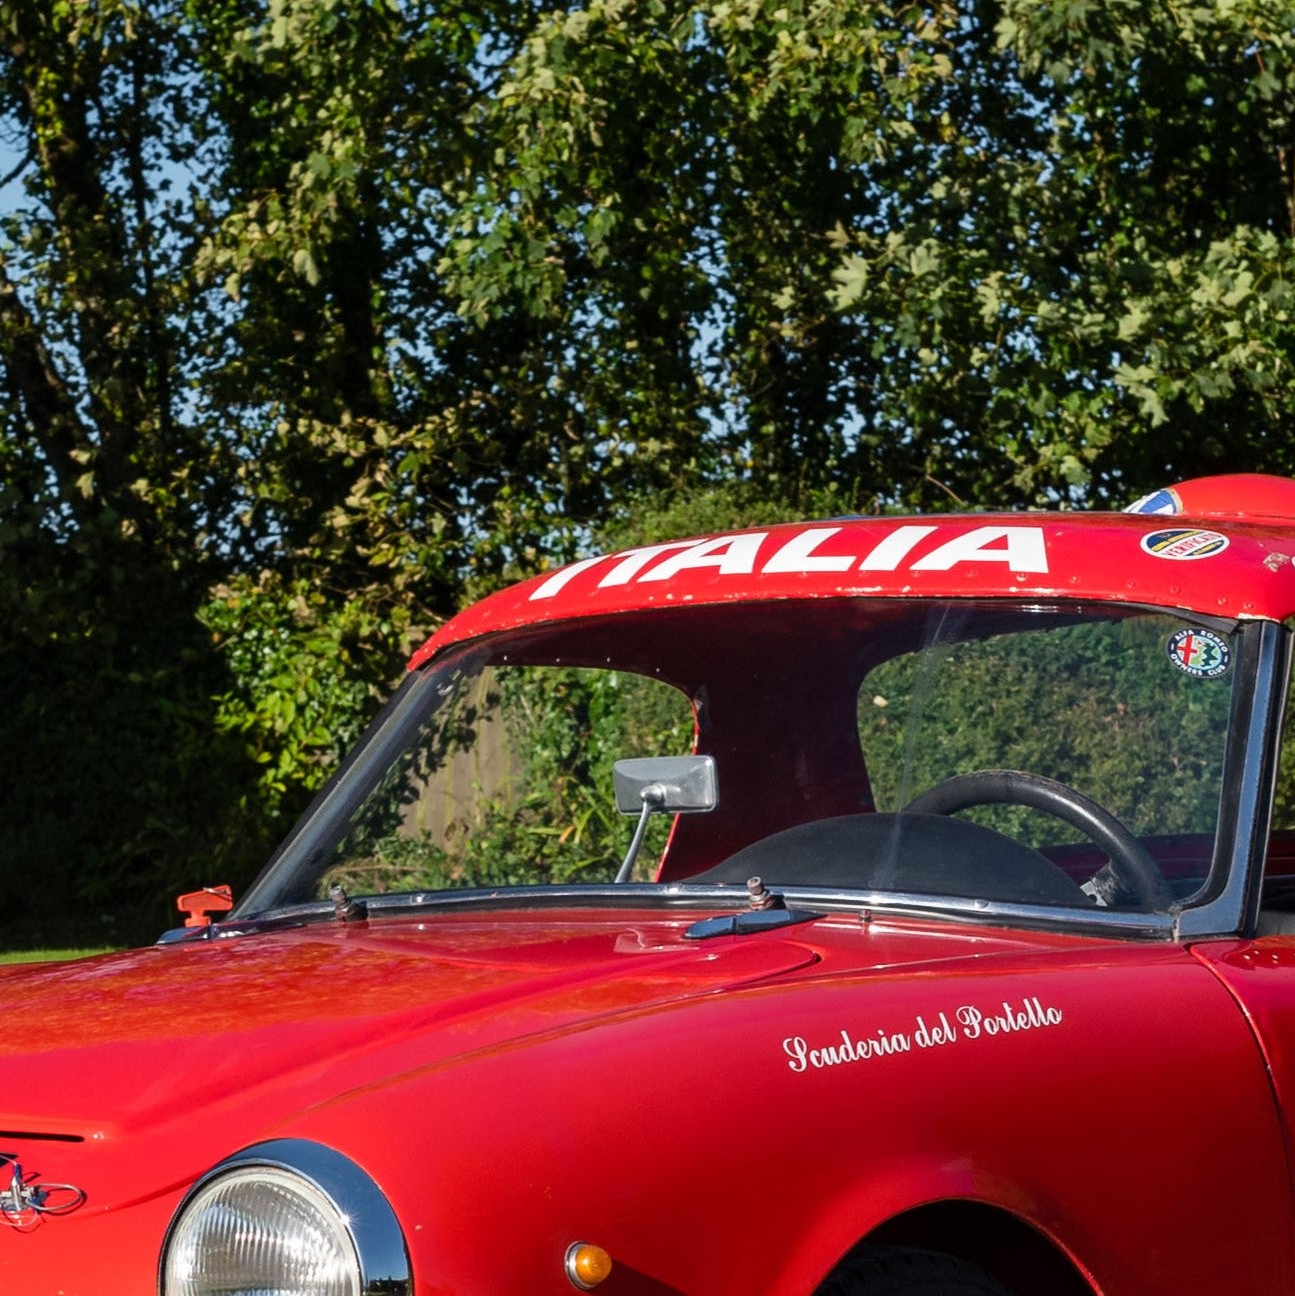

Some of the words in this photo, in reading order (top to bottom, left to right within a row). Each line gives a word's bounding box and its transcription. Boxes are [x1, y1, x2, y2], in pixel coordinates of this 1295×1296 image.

[529, 526, 1048, 600] ITALIA
[1170, 653, 1203, 676] OWNERS
[1207, 664, 1226, 676] CLUB
[1174, 629, 1194, 641] ALFA
[1200, 630, 1228, 653] ROMEO
[782, 1030, 911, 1072] Scuderia
[914, 1012, 956, 1048] del
[956, 997, 1063, 1039] Portello
